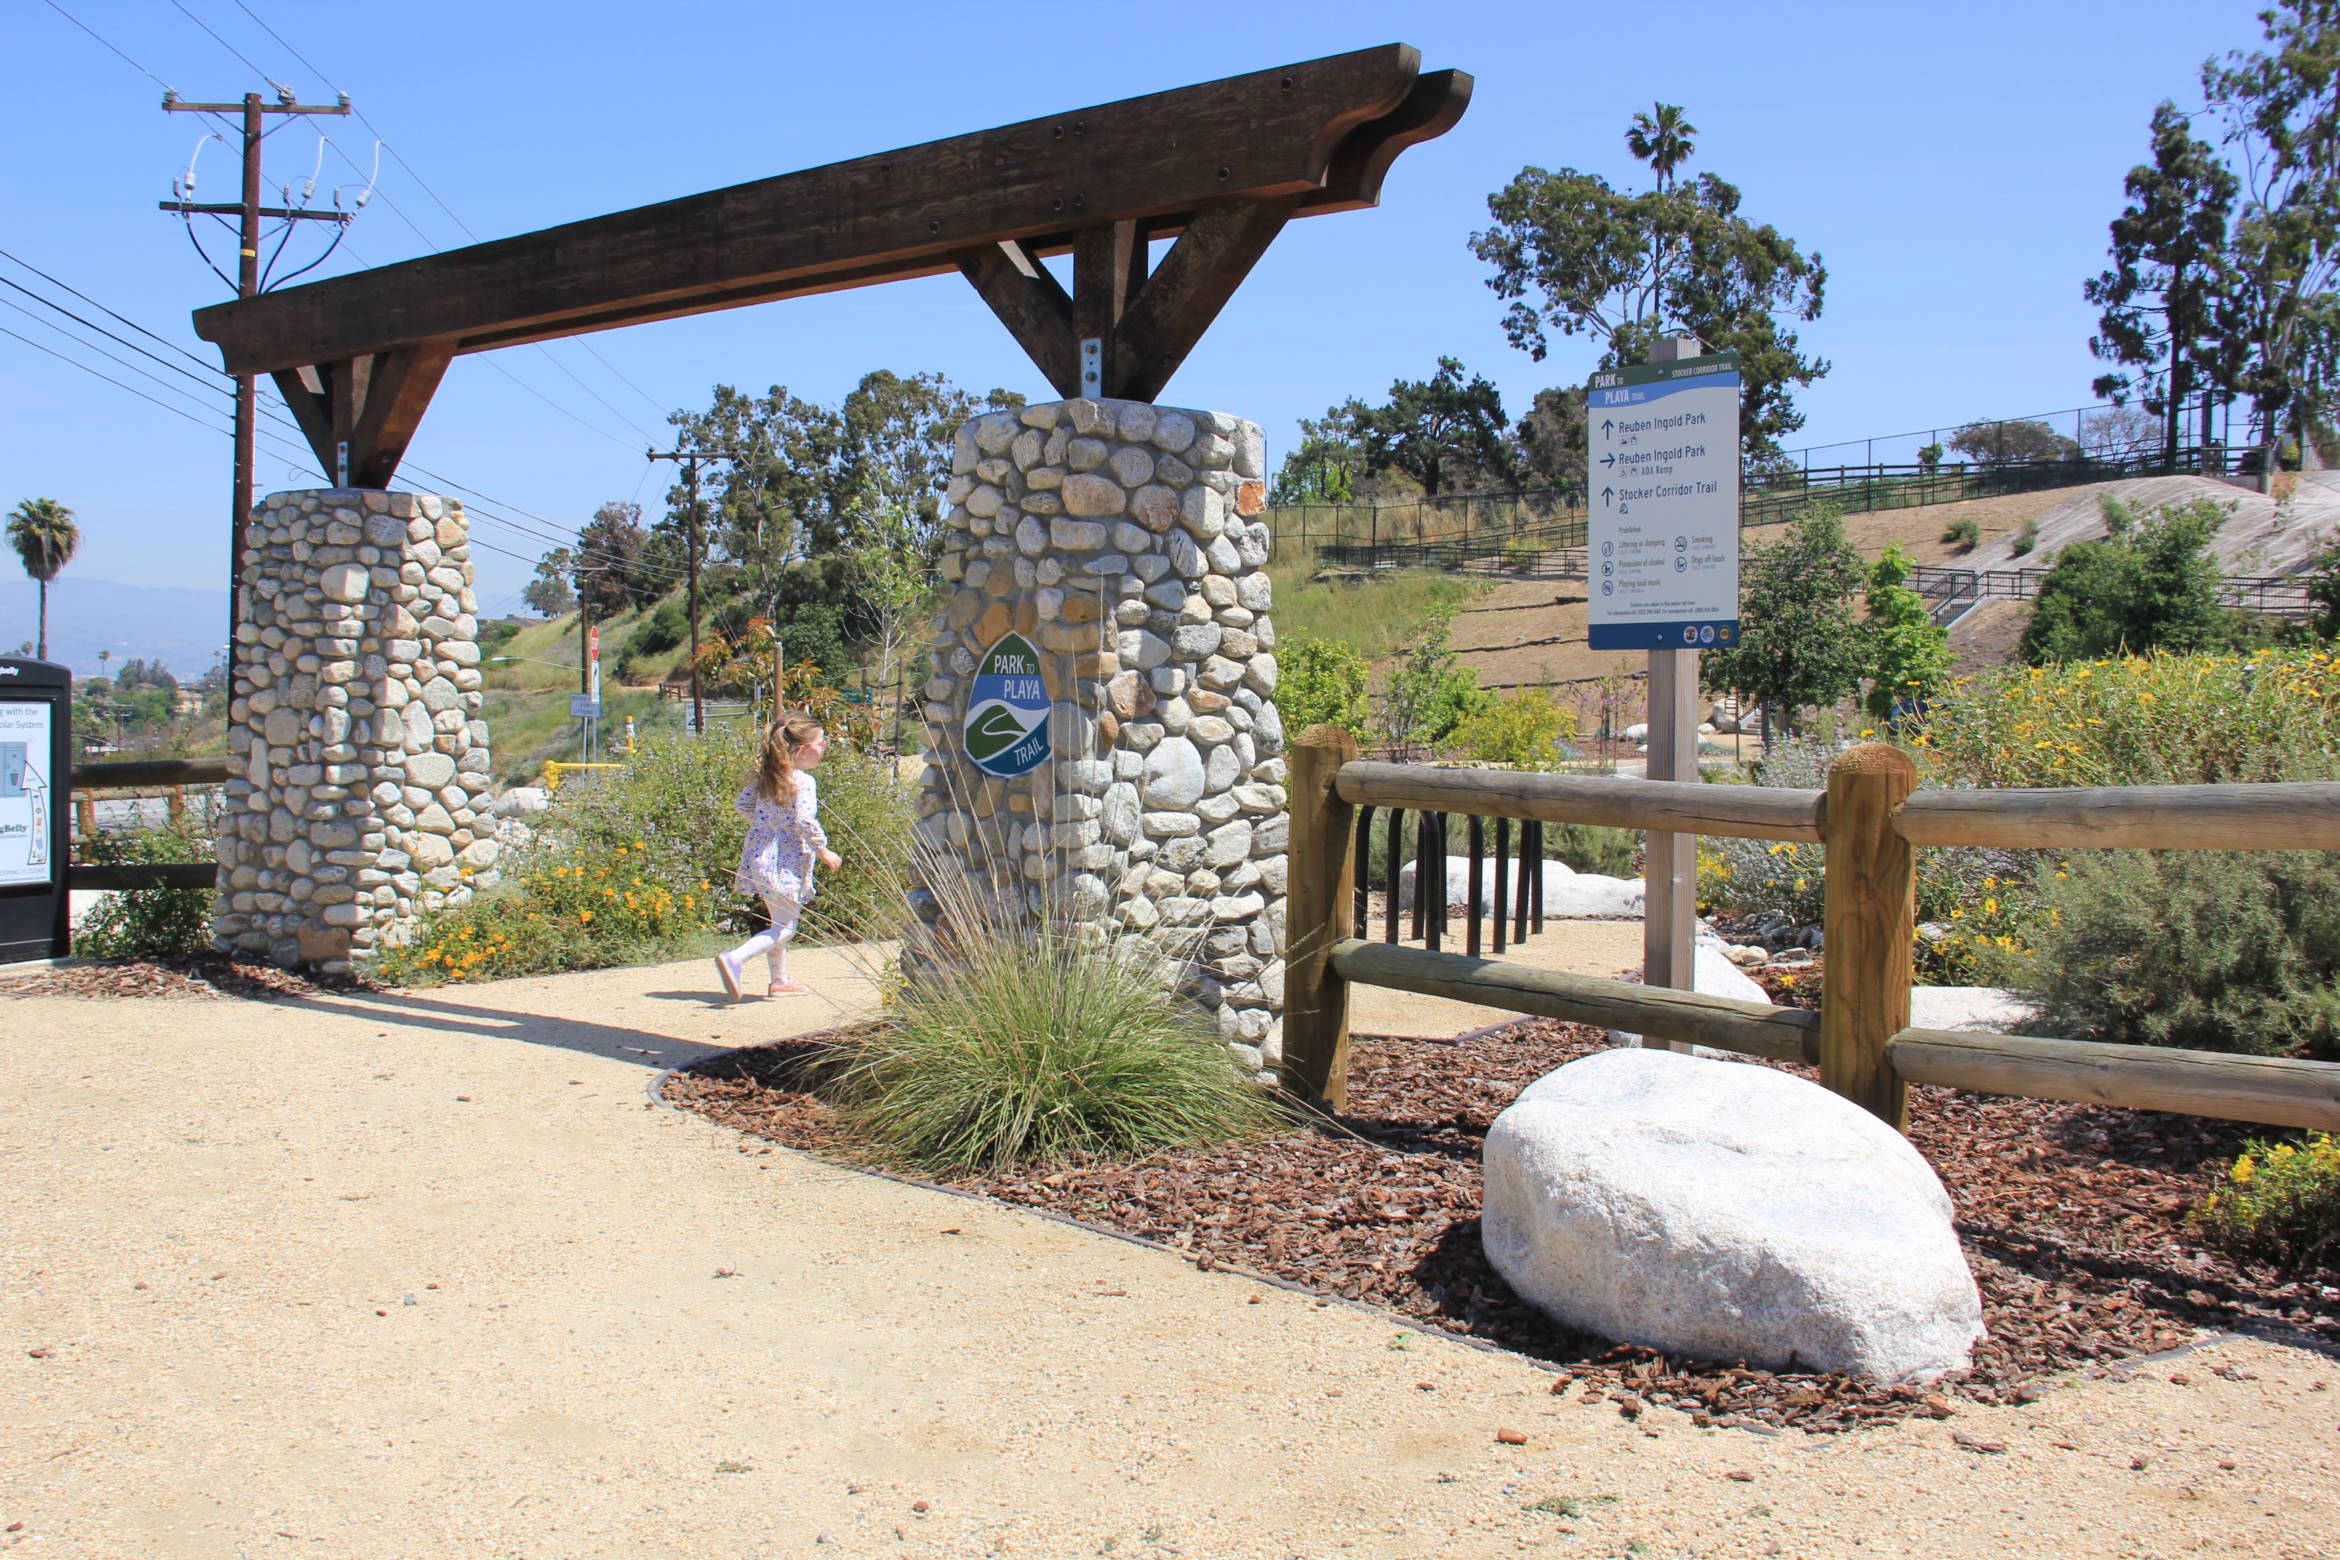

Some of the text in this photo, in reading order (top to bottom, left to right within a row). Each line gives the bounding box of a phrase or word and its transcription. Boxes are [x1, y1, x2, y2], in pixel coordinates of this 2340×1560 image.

[1671, 362, 1733, 378] STOCKER CORRIDOR TRAIL
[1595, 373, 1624, 389] PARK TO
[1605, 389, 1630, 405] PLAYA
[1619, 412, 1706, 434] Reuben Ingold Park
[1619, 444, 1706, 465] Reuben Ingold Park
[1641, 467, 1654, 476] ADA
[1619, 481, 1717, 501] Stocker Corridor Trail
[1618, 541, 1638, 549] Littering
[1645, 538, 1665, 547] dumping
[1691, 535, 1713, 544] Smoking
[1691, 555, 1703, 564] Dogs
[1618, 579, 1636, 588] Playing
[1636, 578, 1647, 586] loud
[994, 655, 1035, 674] PARK TO
[1004, 680, 1041, 700] PLAYA
[6, 707, 23, 716] with
[25, 707, 39, 716] the
[16, 720, 44, 731] System
[1014, 738, 1044, 766] TRAIL
